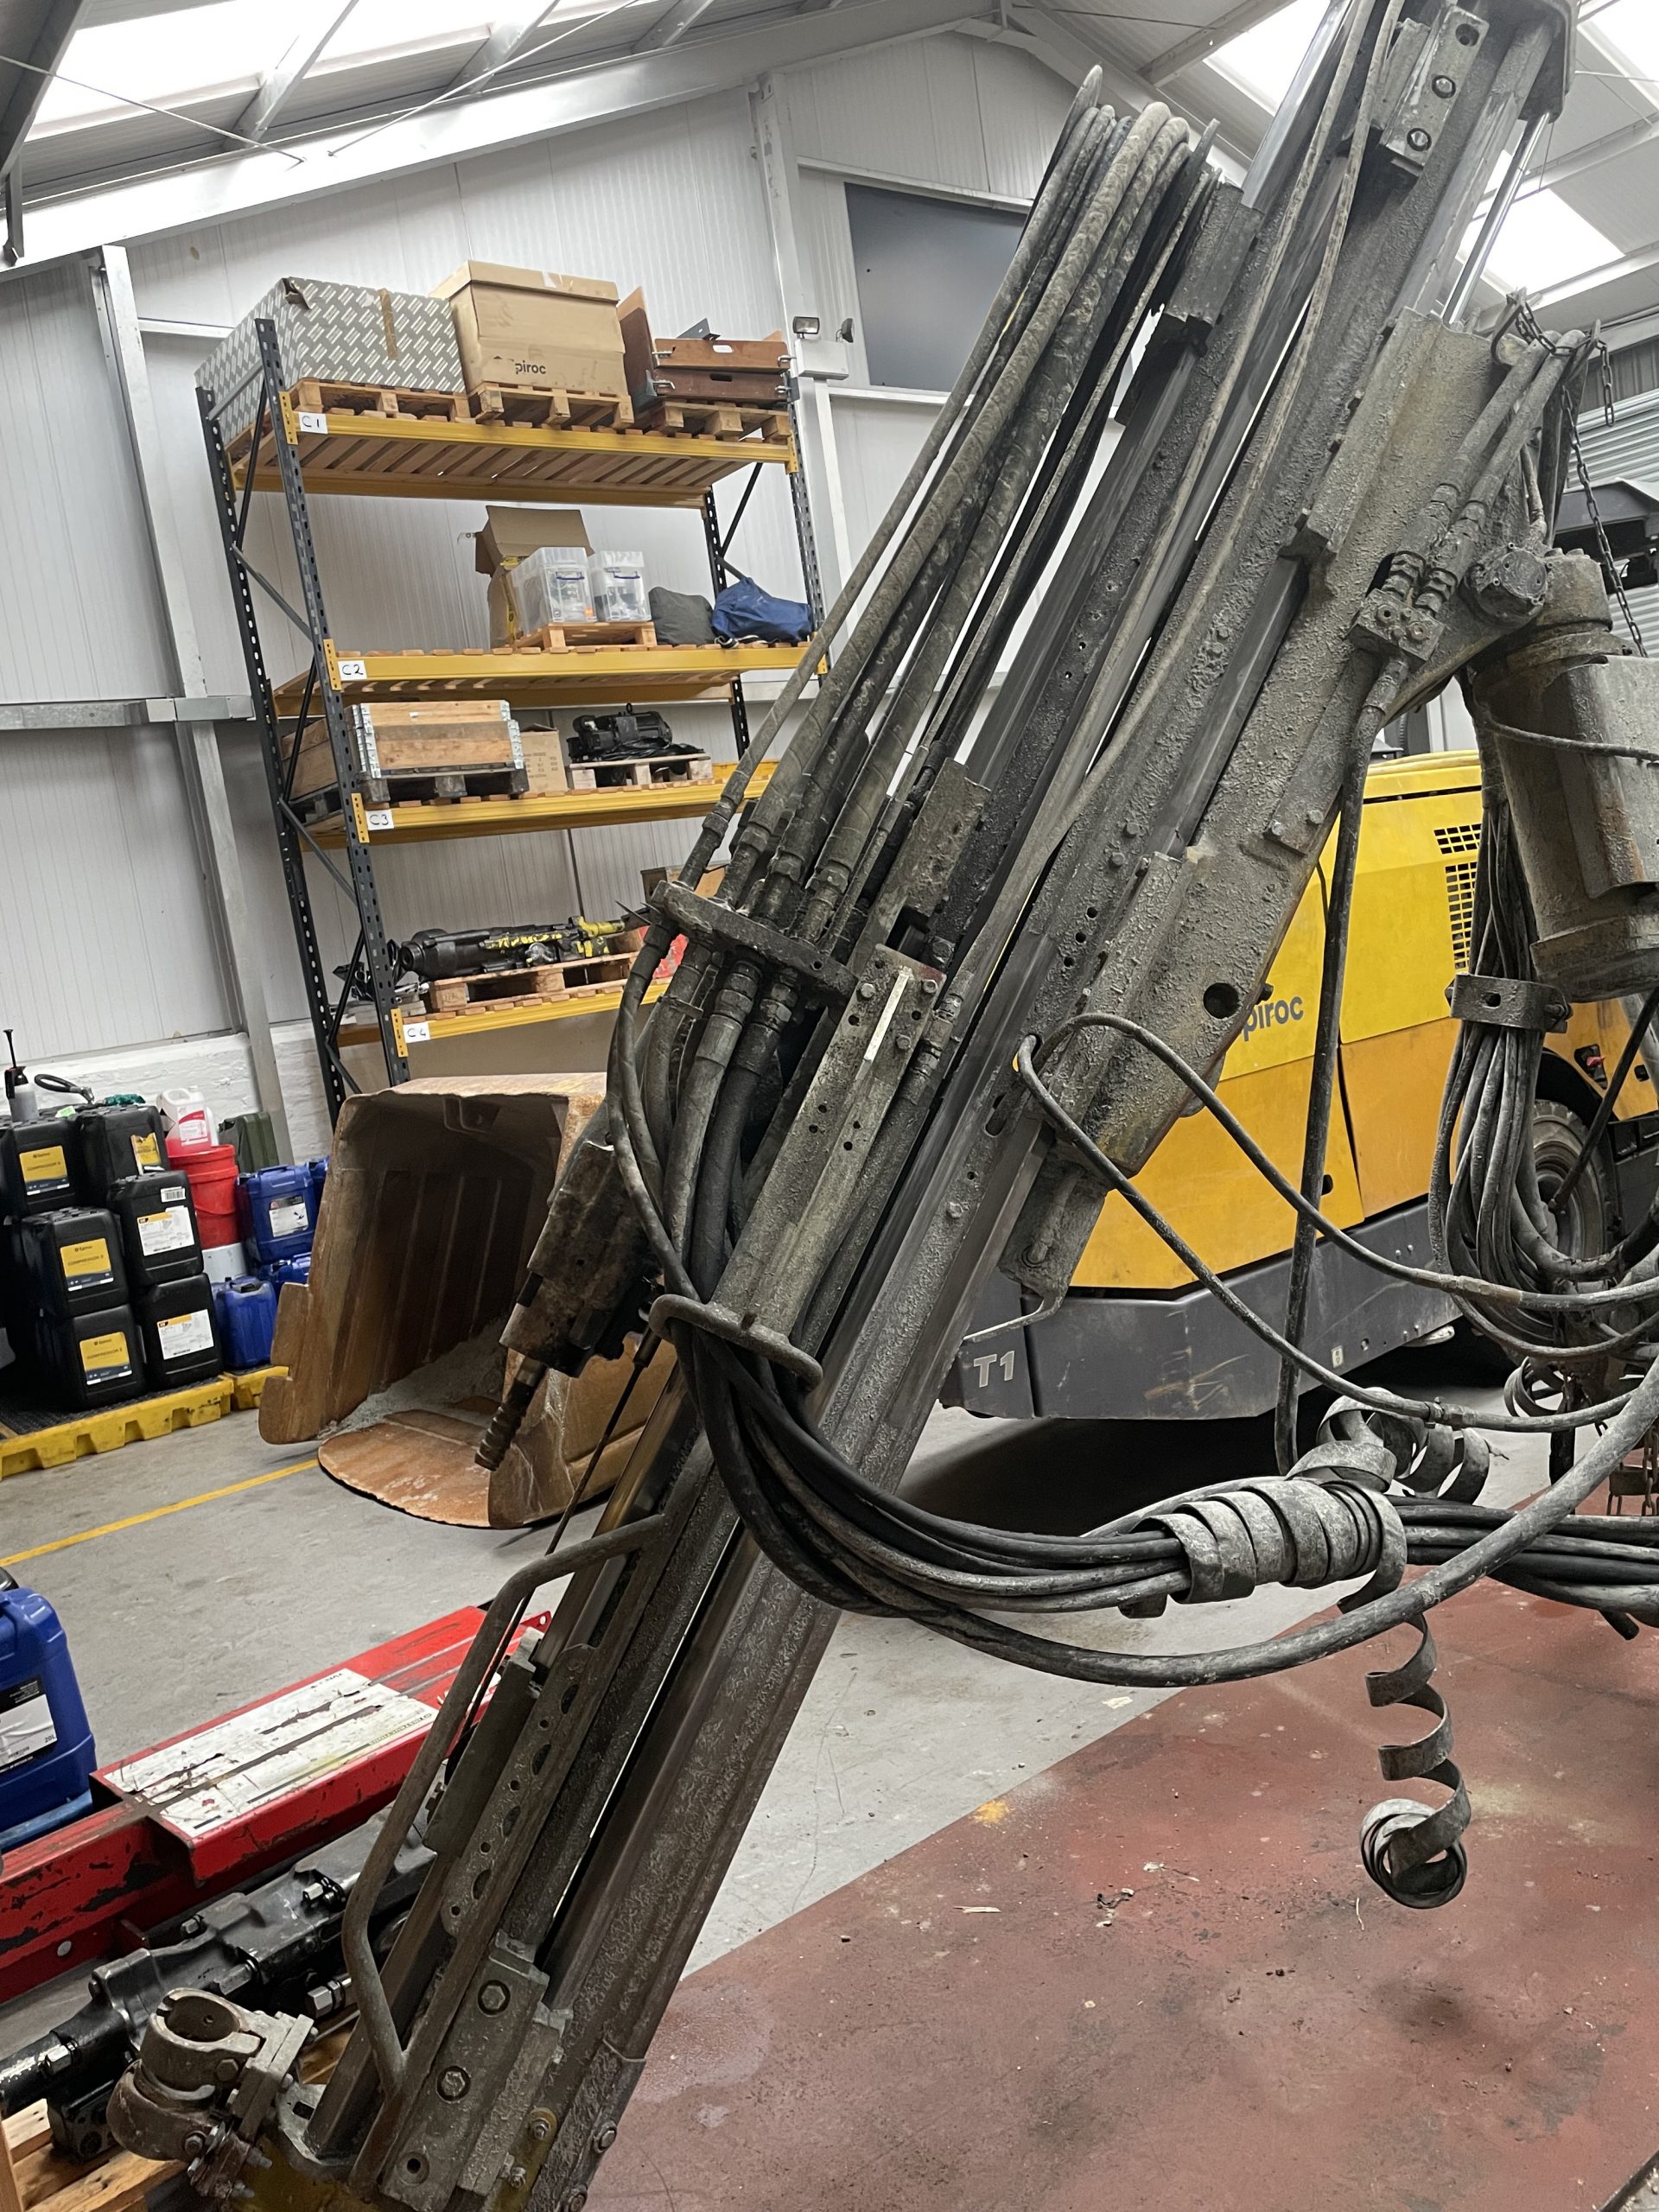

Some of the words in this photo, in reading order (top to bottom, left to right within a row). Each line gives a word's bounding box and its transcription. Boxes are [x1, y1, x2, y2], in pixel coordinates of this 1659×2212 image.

[513, 359, 546, 375] piroc
[302, 415, 320, 428] C1
[341, 664, 364, 675] C2
[369, 814, 389, 825] C3
[1243, 995, 1304, 1042] piroc
[407, 1027, 426, 1038] C4
[973, 1350, 1015, 1388] T1
